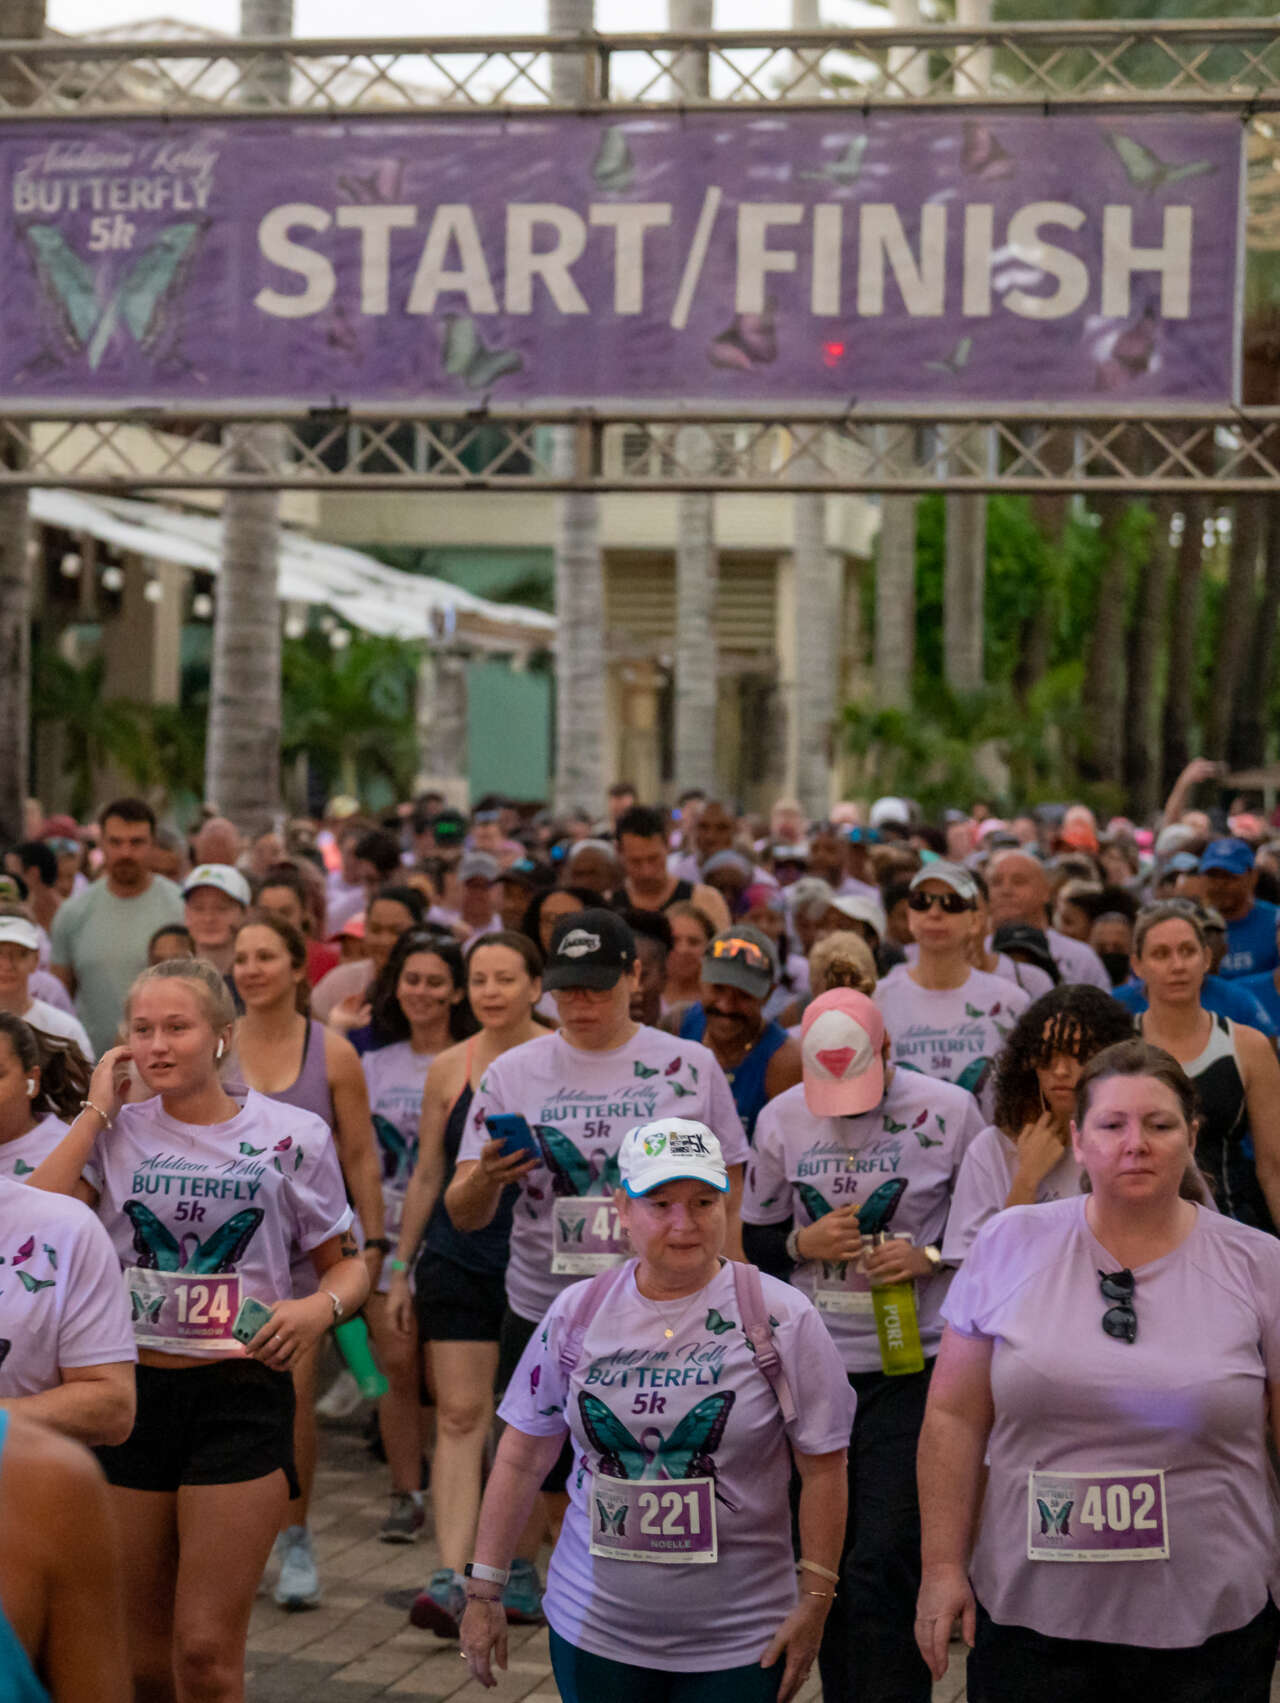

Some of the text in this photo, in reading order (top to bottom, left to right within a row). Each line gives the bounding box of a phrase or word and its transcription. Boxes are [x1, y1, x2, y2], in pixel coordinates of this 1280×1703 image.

[13, 176, 214, 213] BUTTERFLY
[88, 215, 136, 251] 5k
[254, 186, 1194, 330] START/FINISH
[540, 1102, 655, 1122] BUTTERFLY
[582, 1120, 611, 1138] 5k
[134, 1152, 209, 1174] Addison
[797, 1157, 901, 1177] BUTTERFLY
[131, 1175, 262, 1200] BUTTERFLY
[832, 1177, 858, 1194] 5k
[174, 1201, 206, 1222] 5k
[174, 1284, 231, 1324] 124
[584, 1366, 725, 1388] BUTTERFLY
[632, 1391, 666, 1414] 5k
[638, 1491, 700, 1535] 221
[1080, 1483, 1157, 1531] 402
[651, 1539, 691, 1549] NOELLE
